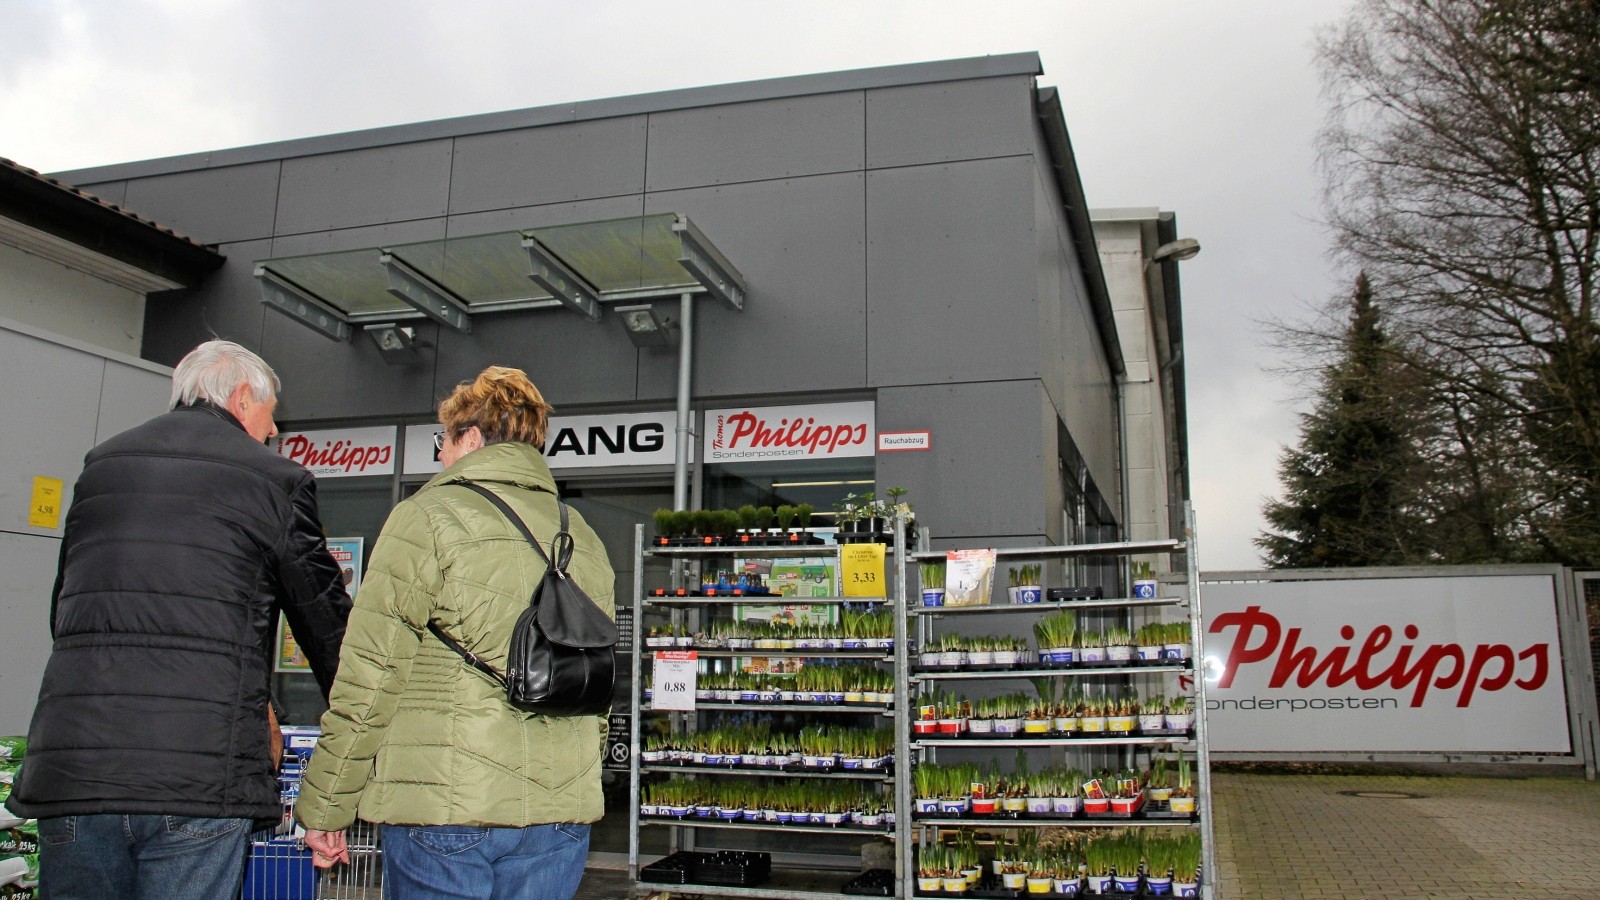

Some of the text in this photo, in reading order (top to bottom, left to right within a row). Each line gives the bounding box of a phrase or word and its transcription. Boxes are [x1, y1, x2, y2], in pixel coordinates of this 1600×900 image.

[713, 415, 724, 450] Thomas
[727, 411, 867, 454] Philipps
[884, 437, 924, 445] Rauchabzug
[285, 434, 391, 472] Philipps
[712, 449, 804, 459] Sonderposten
[853, 572, 876, 583] 3,33
[1208, 605, 1549, 708] Philipps
[664, 682, 686, 693] 0,88
[1204, 696, 1398, 712] onderposten
